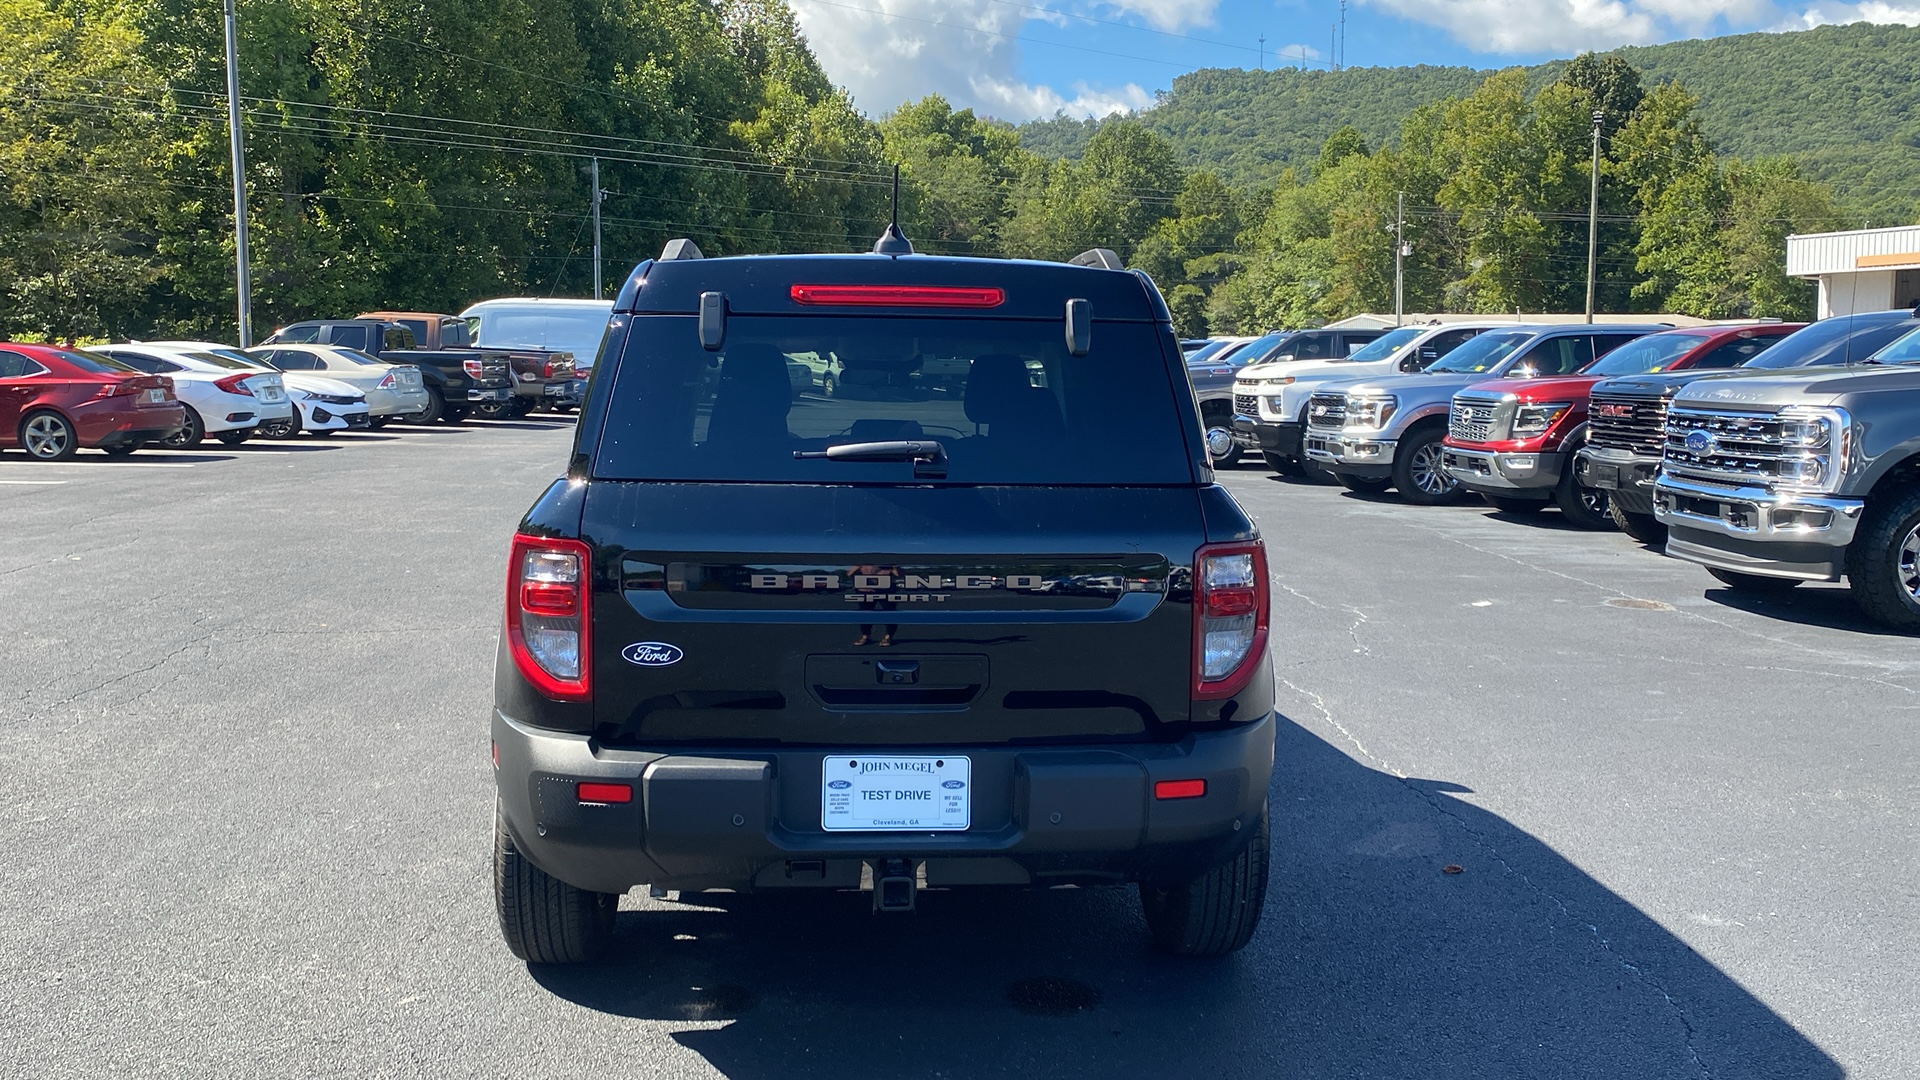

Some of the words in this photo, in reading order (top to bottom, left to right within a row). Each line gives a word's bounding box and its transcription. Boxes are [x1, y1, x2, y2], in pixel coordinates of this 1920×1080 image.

[751, 574, 1042, 589] BRONCO
[844, 593, 951, 602] SPORT
[633, 645, 672, 661] Ford
[859, 762, 890, 775] JOHN
[894, 762, 935, 774] MEGEL
[861, 790, 891, 800] TEST
[895, 790, 931, 800] DRIVE
